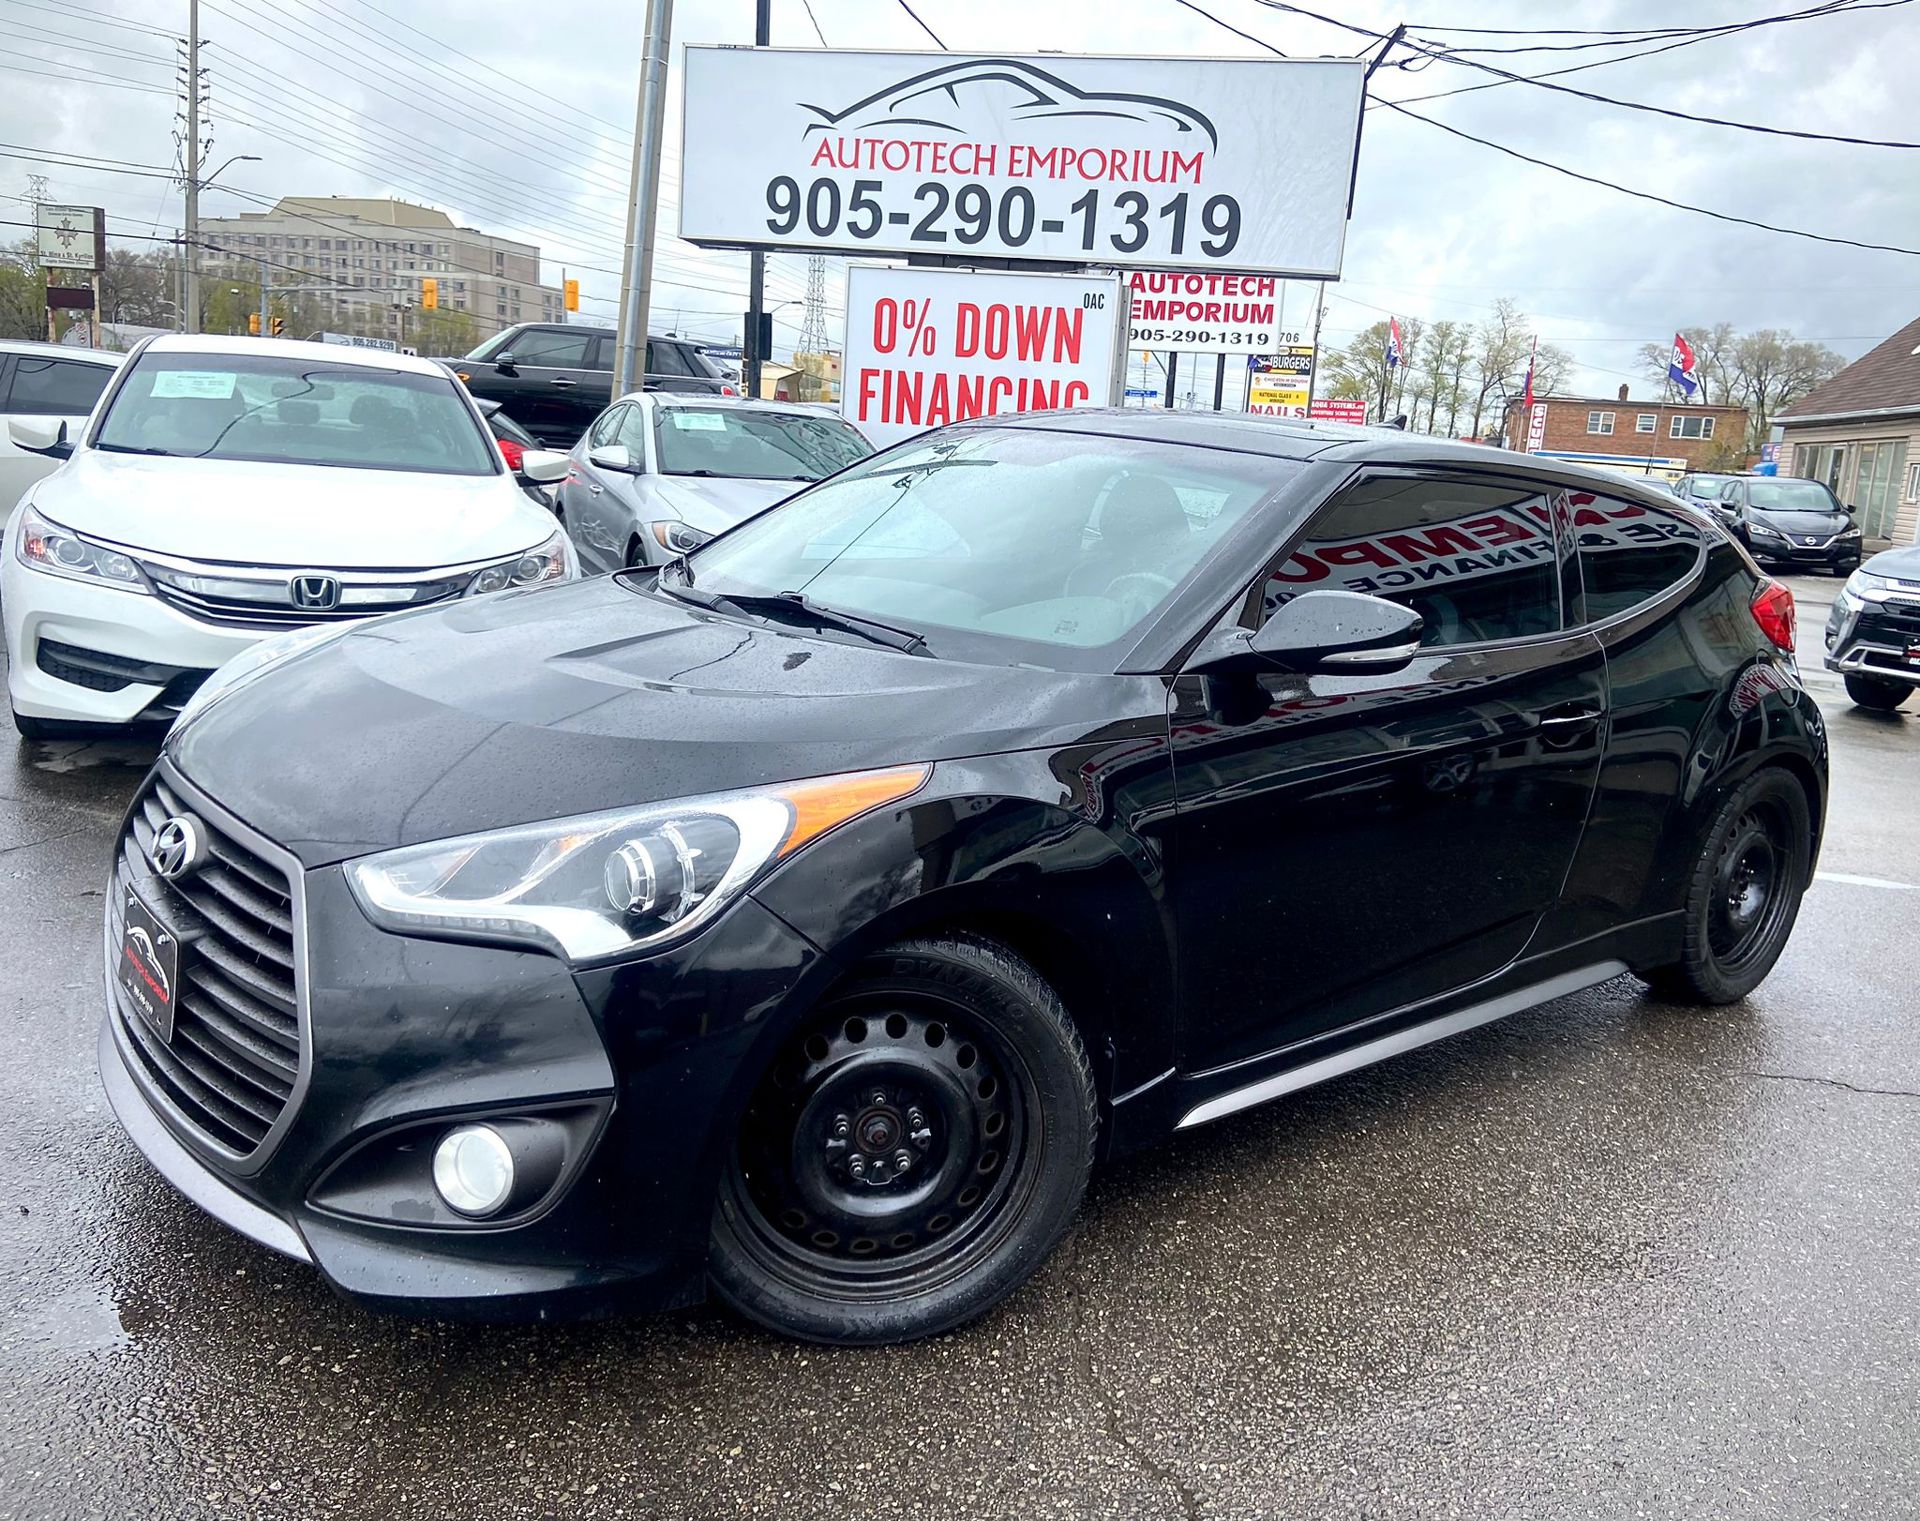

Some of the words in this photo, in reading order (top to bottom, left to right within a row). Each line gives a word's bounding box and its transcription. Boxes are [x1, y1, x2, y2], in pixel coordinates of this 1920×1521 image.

[811, 137, 996, 176] AUTOTECH
[1007, 145, 1205, 184] EMPORIUM
[765, 175, 1241, 258] 905-290-1319
[1129, 272, 1275, 297] AUTOTECH
[1083, 292, 1105, 310] OAC
[1130, 299, 1274, 324] EMPORIUM
[873, 297, 936, 357] 0%
[955, 302, 1084, 364] DOWN
[1129, 328, 1269, 345] 905-290-1319
[1279, 332, 1300, 343] 706
[1254, 354, 1311, 370] BURGERS
[1250, 404, 1305, 418] NAILS
[1528, 406, 1545, 452] SCUB
